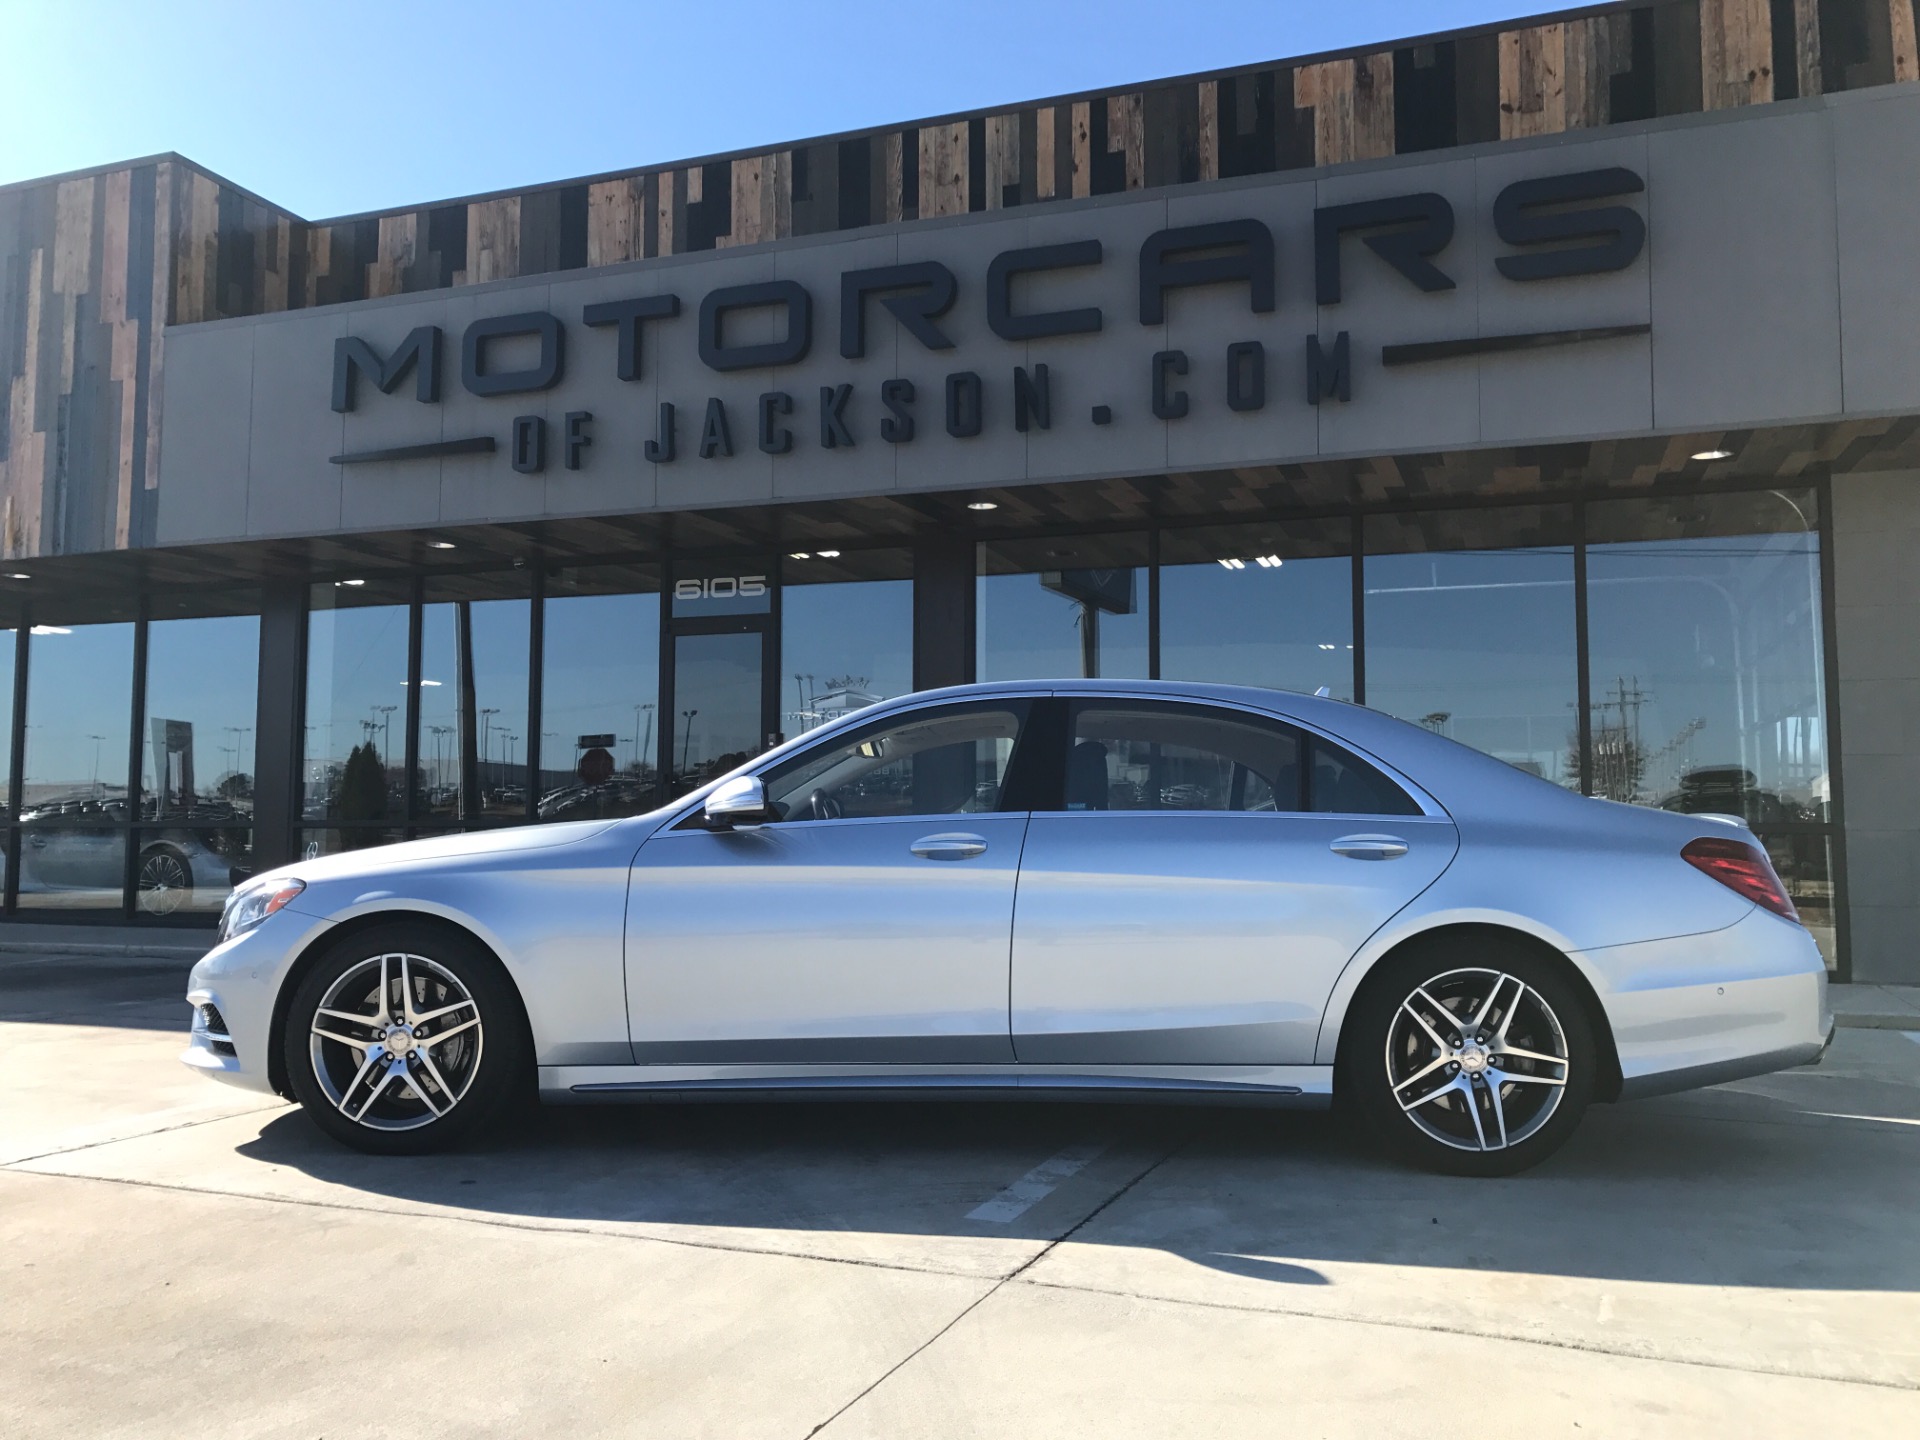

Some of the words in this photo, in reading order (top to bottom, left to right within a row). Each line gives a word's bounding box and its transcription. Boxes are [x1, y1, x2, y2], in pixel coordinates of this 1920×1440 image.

[331, 166, 1646, 413] MOTORCARS
[511, 410, 593, 473] OF
[644, 330, 1351, 464] JACKSON.COM
[675, 575, 766, 600] 6105
